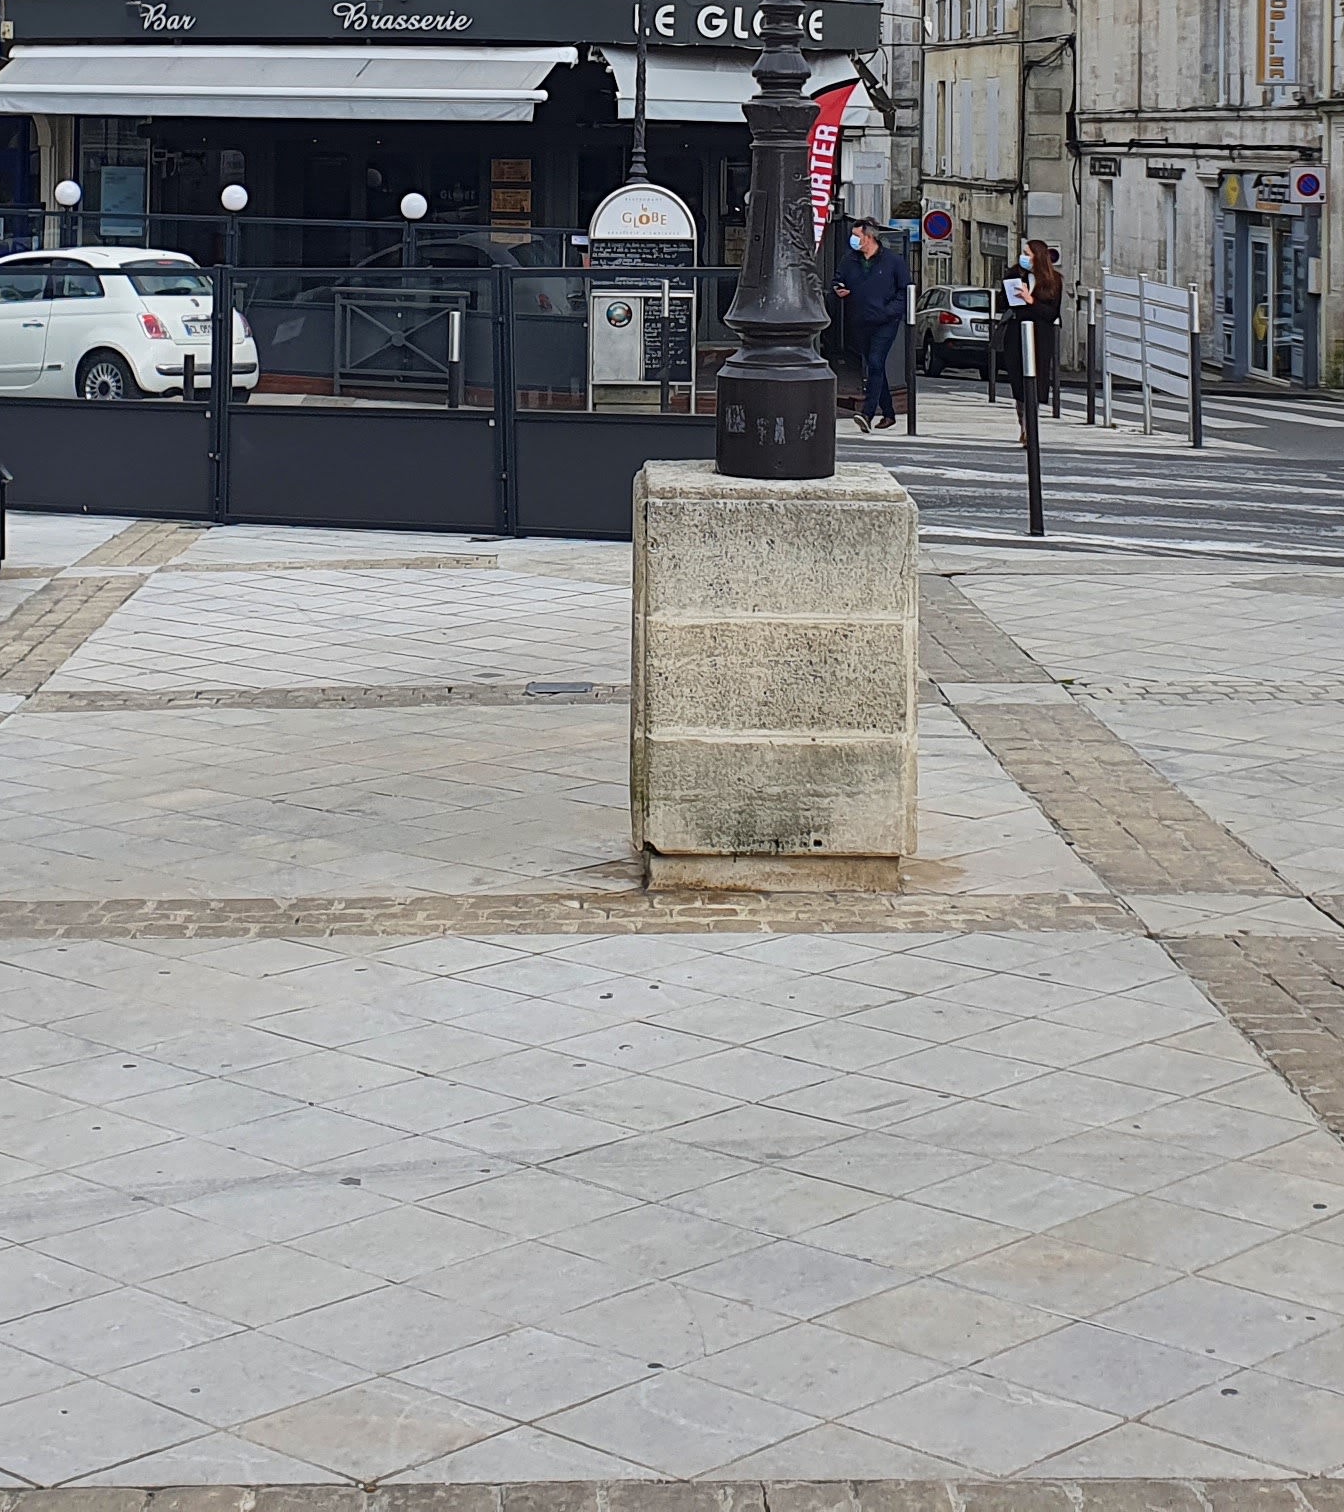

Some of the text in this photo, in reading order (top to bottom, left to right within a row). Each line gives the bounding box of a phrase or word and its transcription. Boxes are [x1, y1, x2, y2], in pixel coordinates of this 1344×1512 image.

[140, 2, 197, 31] Bar
[333, 1, 473, 31] Brasserie
[696, 4, 824, 41] GLE
[622, 212, 667, 228] GLOBE
